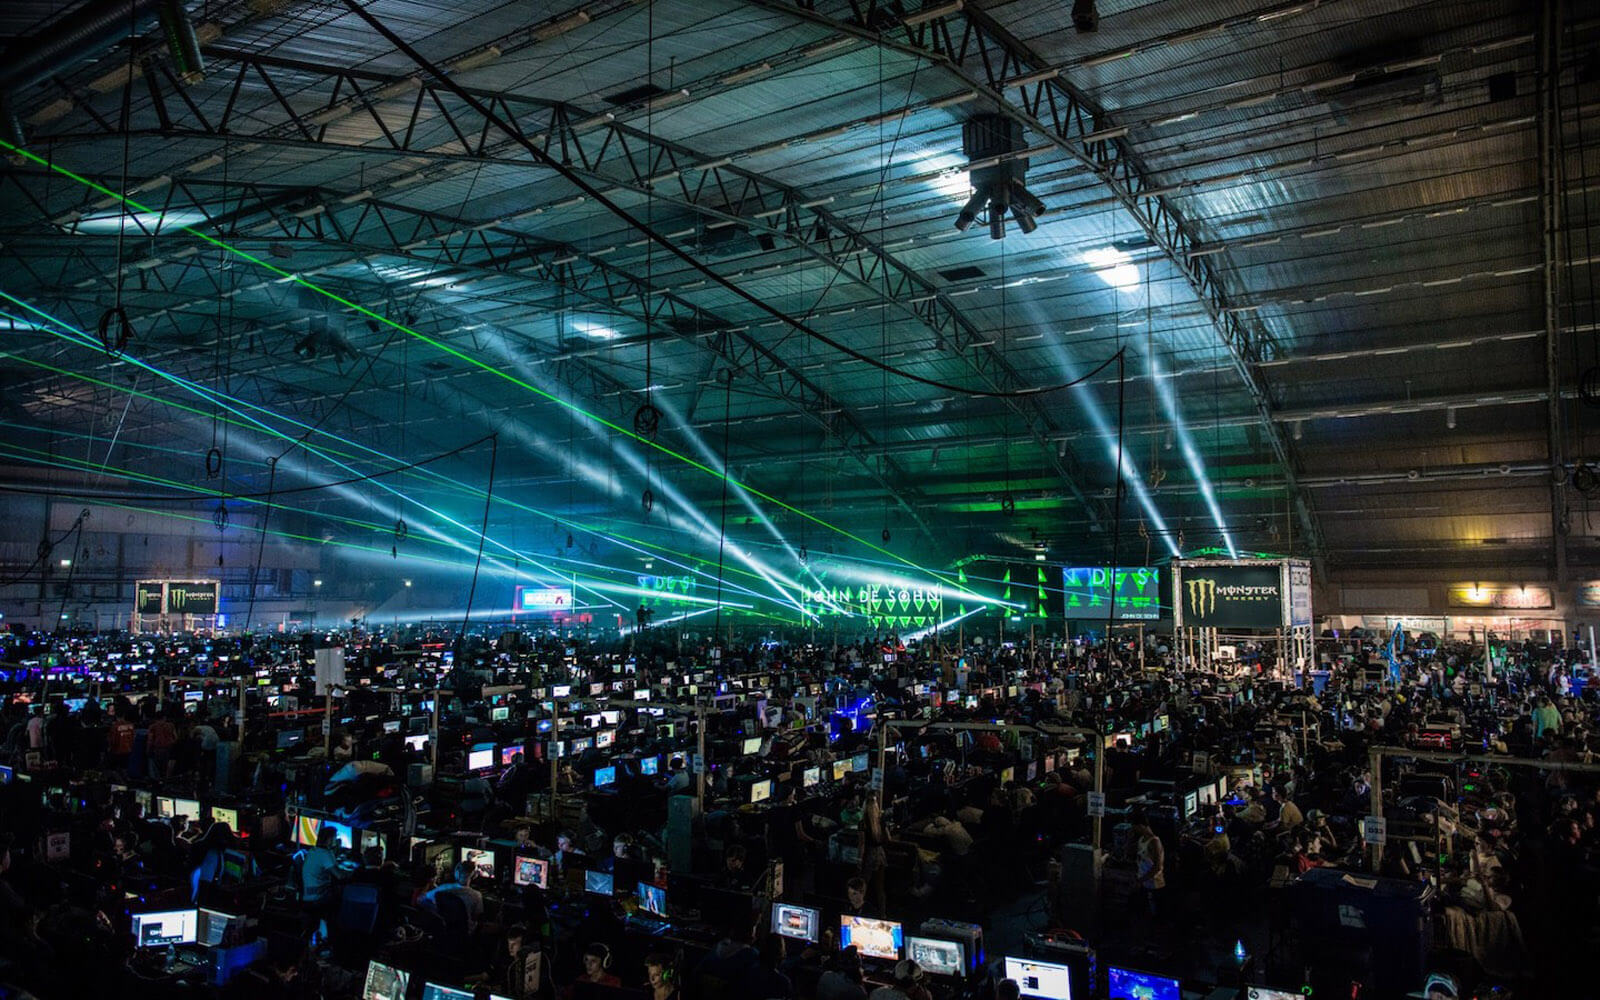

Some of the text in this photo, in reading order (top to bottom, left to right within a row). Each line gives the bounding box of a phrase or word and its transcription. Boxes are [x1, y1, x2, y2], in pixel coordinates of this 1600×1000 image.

[805, 590, 938, 603] JOHN DE SOHN
[1216, 585, 1278, 596] MONSTER
